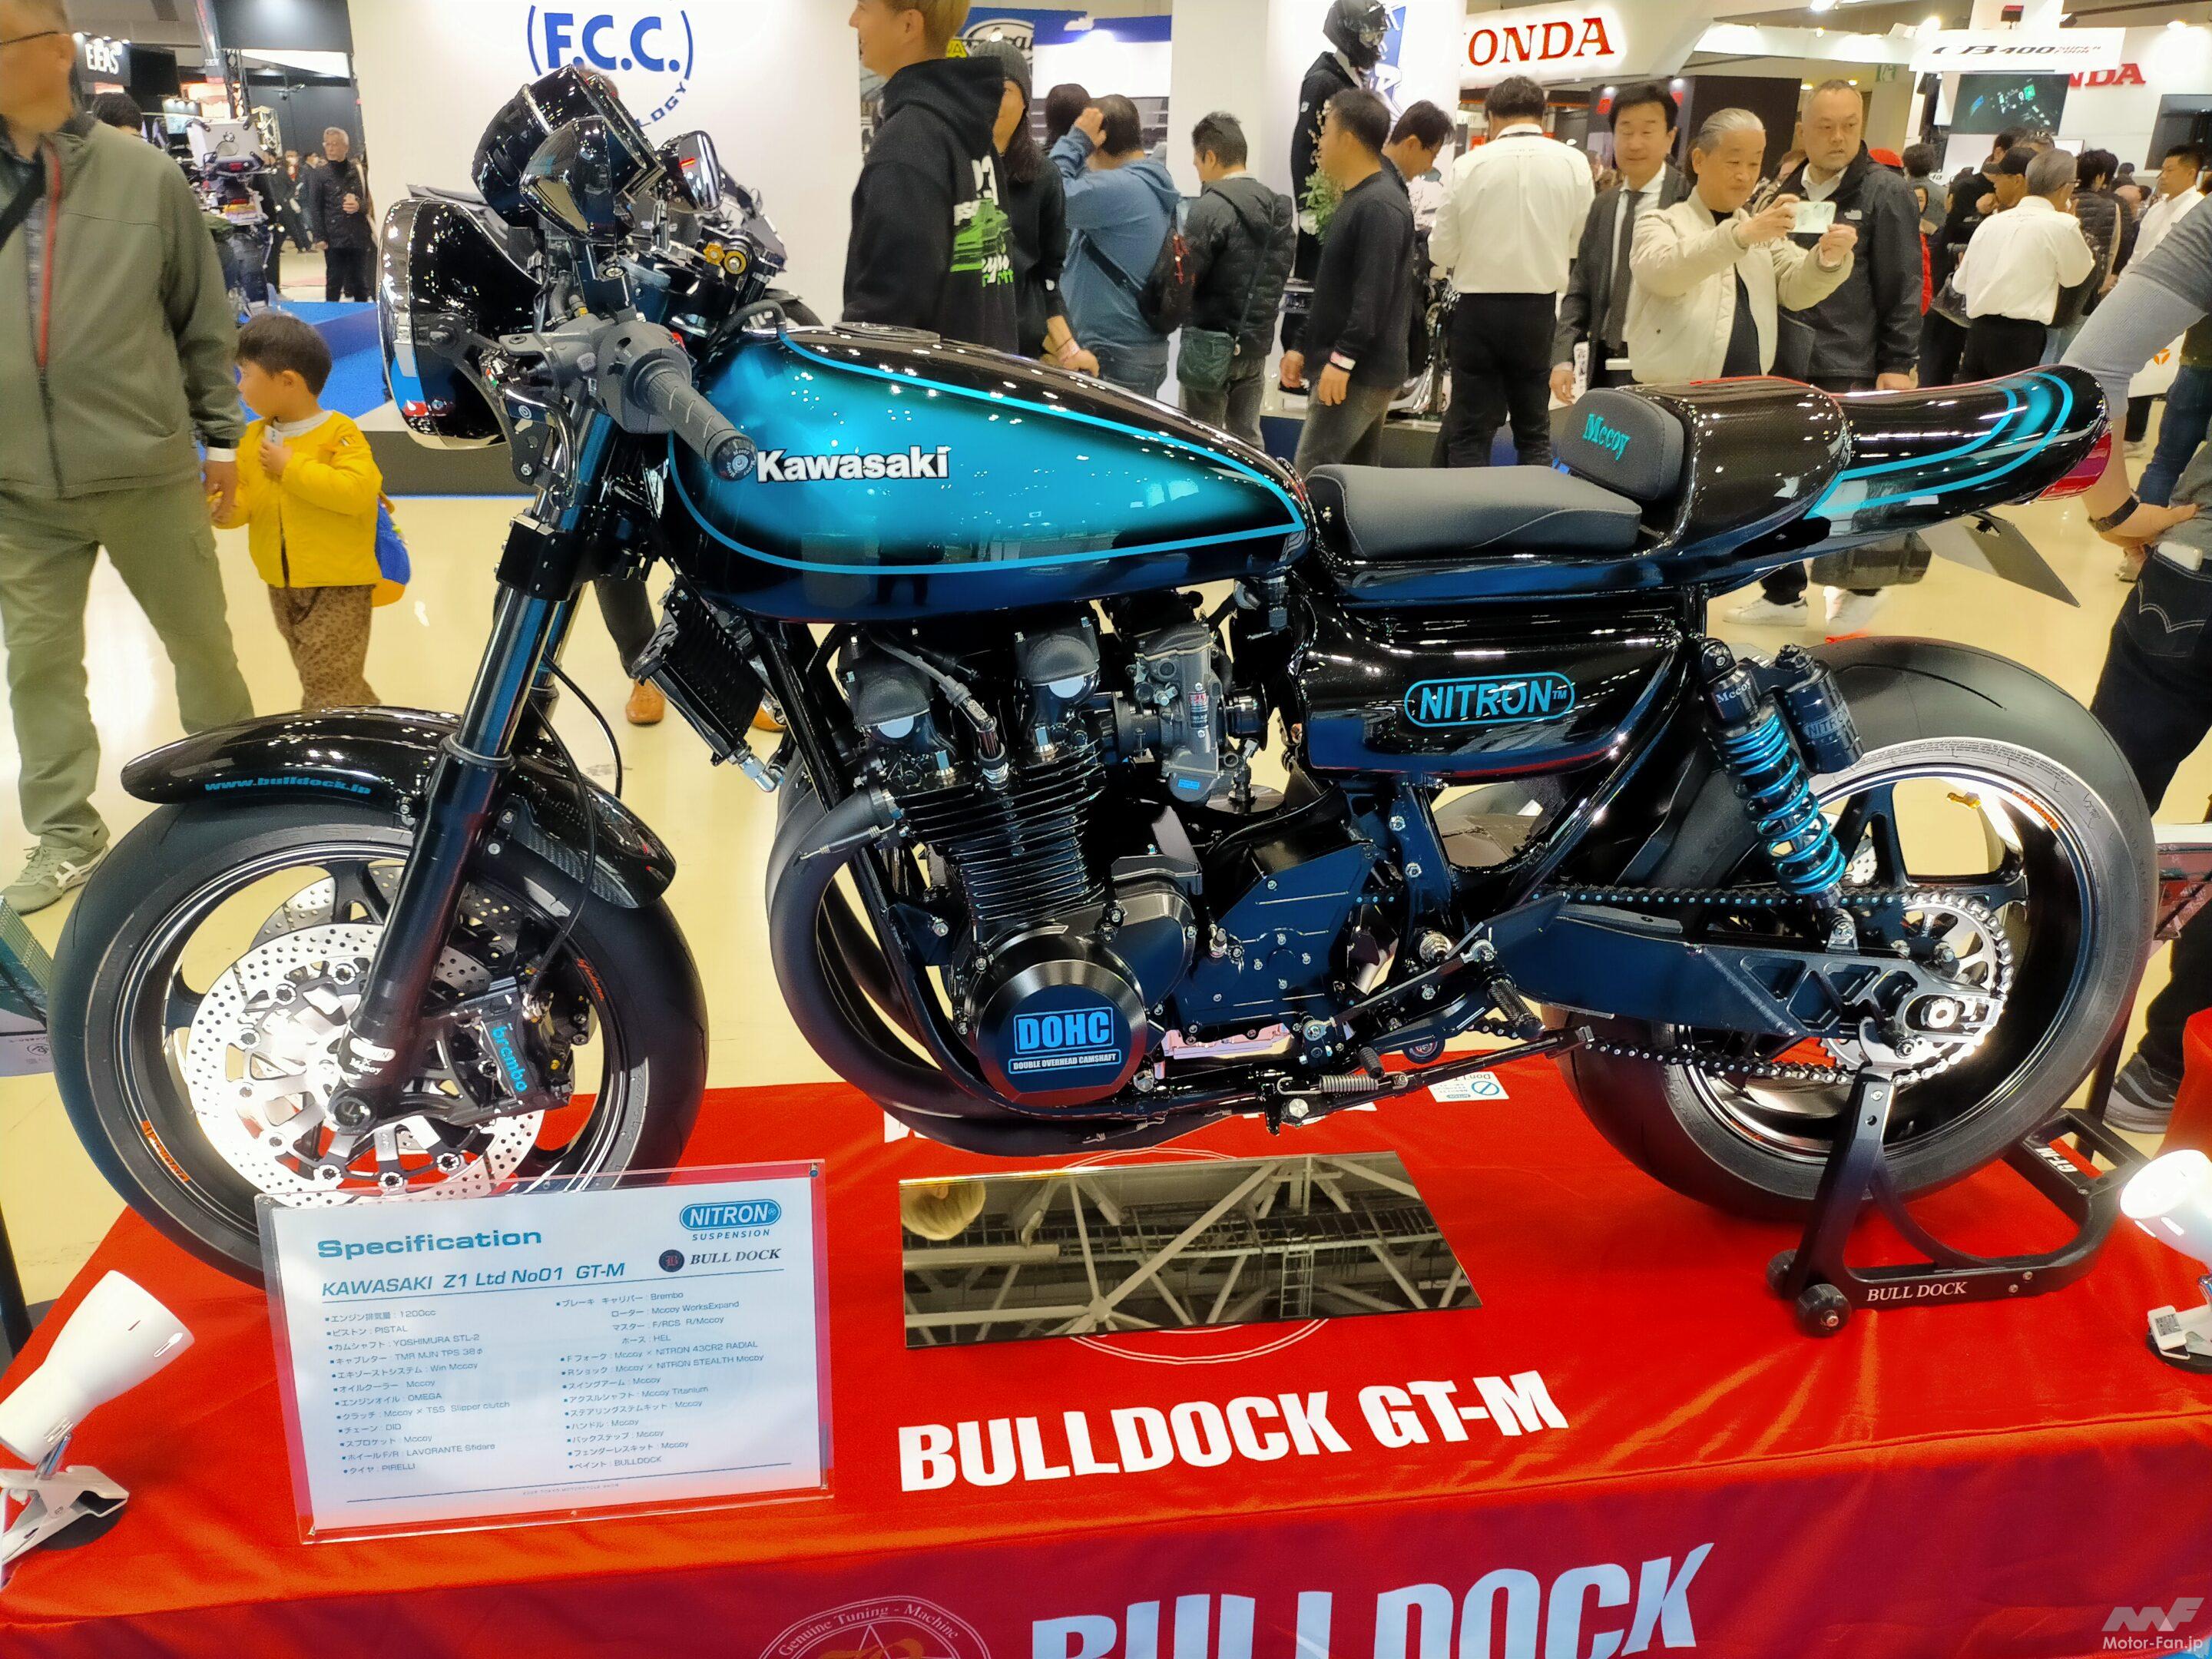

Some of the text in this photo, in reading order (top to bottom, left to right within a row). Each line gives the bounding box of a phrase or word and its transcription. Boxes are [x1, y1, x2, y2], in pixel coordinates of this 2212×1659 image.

[1469, 17, 1614, 66] ONDA
[2069, 63, 2146, 87] NDA
[757, 445, 949, 483] Kawasaki
[1018, 1012, 1110, 1050] DOHC
[492, 1025, 528, 1092] brembo
[1013, 1053, 1117, 1070] DOUBLE OVERHEAD CAMSHAFT
[318, 1230, 541, 1260] Specification
[692, 1229, 770, 1241] SUSPENSION
[690, 1248, 782, 1265] BULL DOCK
[322, 1263, 625, 1296] KAWASAKI Z1 Ltd No01 GT-M
[1866, 1281, 1968, 1302] BULL DOCK
[393, 1336, 450, 1347] YOSHIMURA
[408, 1392, 442, 1402] OMEGA
[426, 1406, 445, 1414] TSS
[899, 1369, 1569, 1492] BULLDOCK GT-M
[779, 1621, 833, 1657] Genuine
[833, 1607, 889, 1626] Tuning
[904, 1604, 959, 1639] Machine
